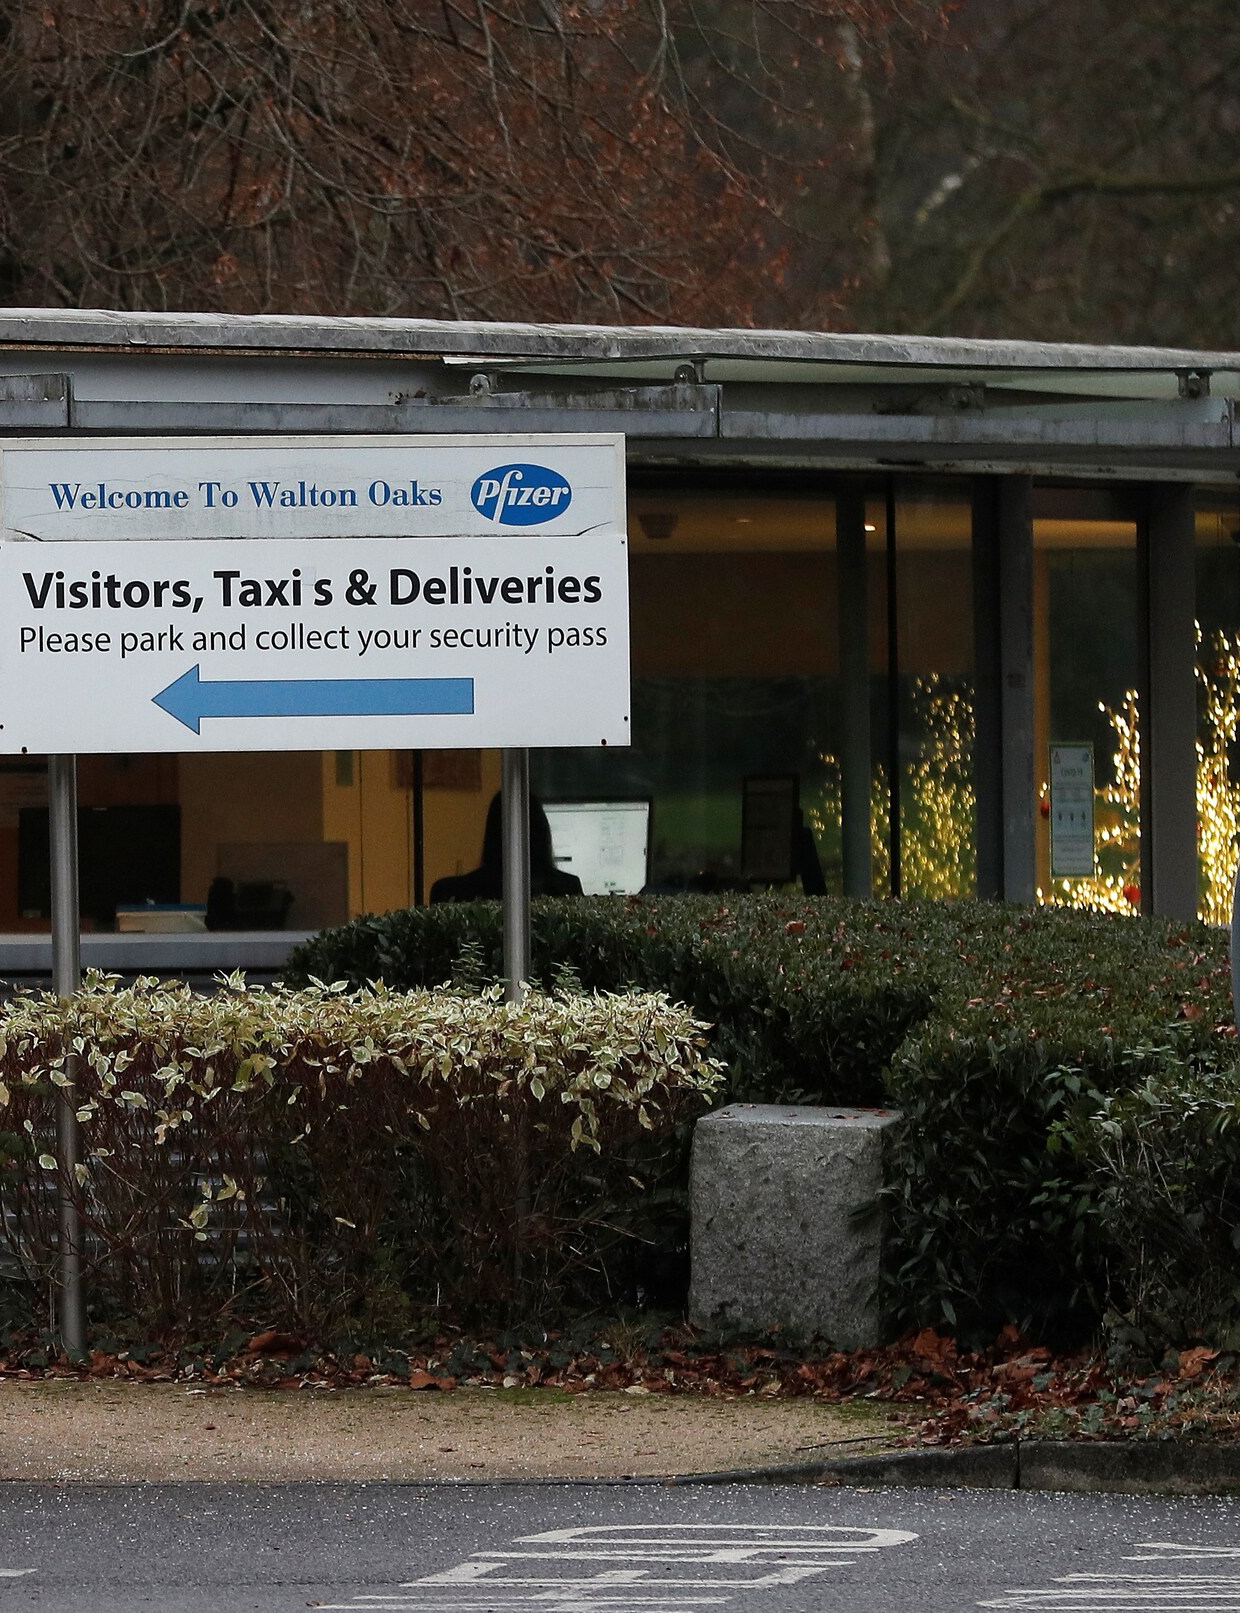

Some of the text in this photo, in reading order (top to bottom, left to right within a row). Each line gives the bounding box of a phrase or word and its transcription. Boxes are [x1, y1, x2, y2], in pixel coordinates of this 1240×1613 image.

[47, 479, 443, 510] Welcome To Walton Oaks
[476, 469, 570, 522] Pfizer
[21, 570, 204, 614] Visitors,
[345, 568, 378, 606] &
[389, 565, 602, 606] Deliveries
[20, 622, 608, 659] Please park and collect your security pass
